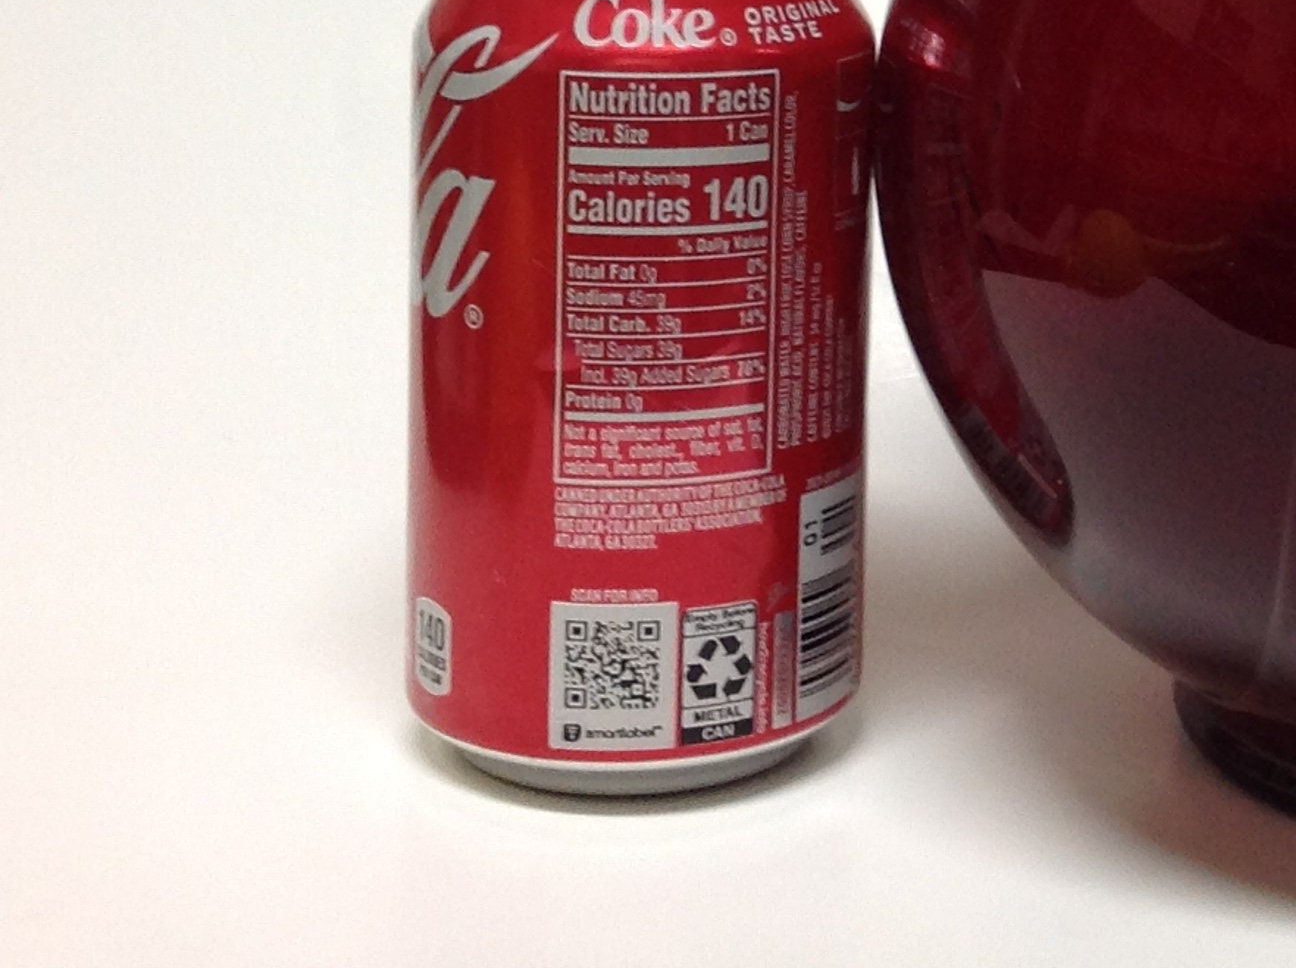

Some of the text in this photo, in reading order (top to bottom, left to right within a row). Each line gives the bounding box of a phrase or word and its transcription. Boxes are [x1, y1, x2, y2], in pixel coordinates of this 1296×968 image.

[749, 21, 822, 45] TASTE
[569, 81, 771, 114] Nutrition Facts
[568, 121, 768, 144] Serv. Size 1 Can
[618, 171, 640, 186] Per
[567, 175, 769, 223] Calories 140
[696, 238, 730, 253] Daily
[733, 236, 768, 249] Value
[567, 262, 605, 279] Total
[609, 264, 636, 280] Fat
[566, 288, 624, 306] Sodium
[566, 314, 604, 331] Total
[608, 316, 650, 332] Carb.
[574, 339, 604, 357] Total
[607, 341, 653, 361] Sugars
[565, 391, 622, 409] Protein
[571, 589, 659, 601] SCAN FOR INFO
[693, 706, 742, 723] METAL
[702, 724, 736, 741] CAN
